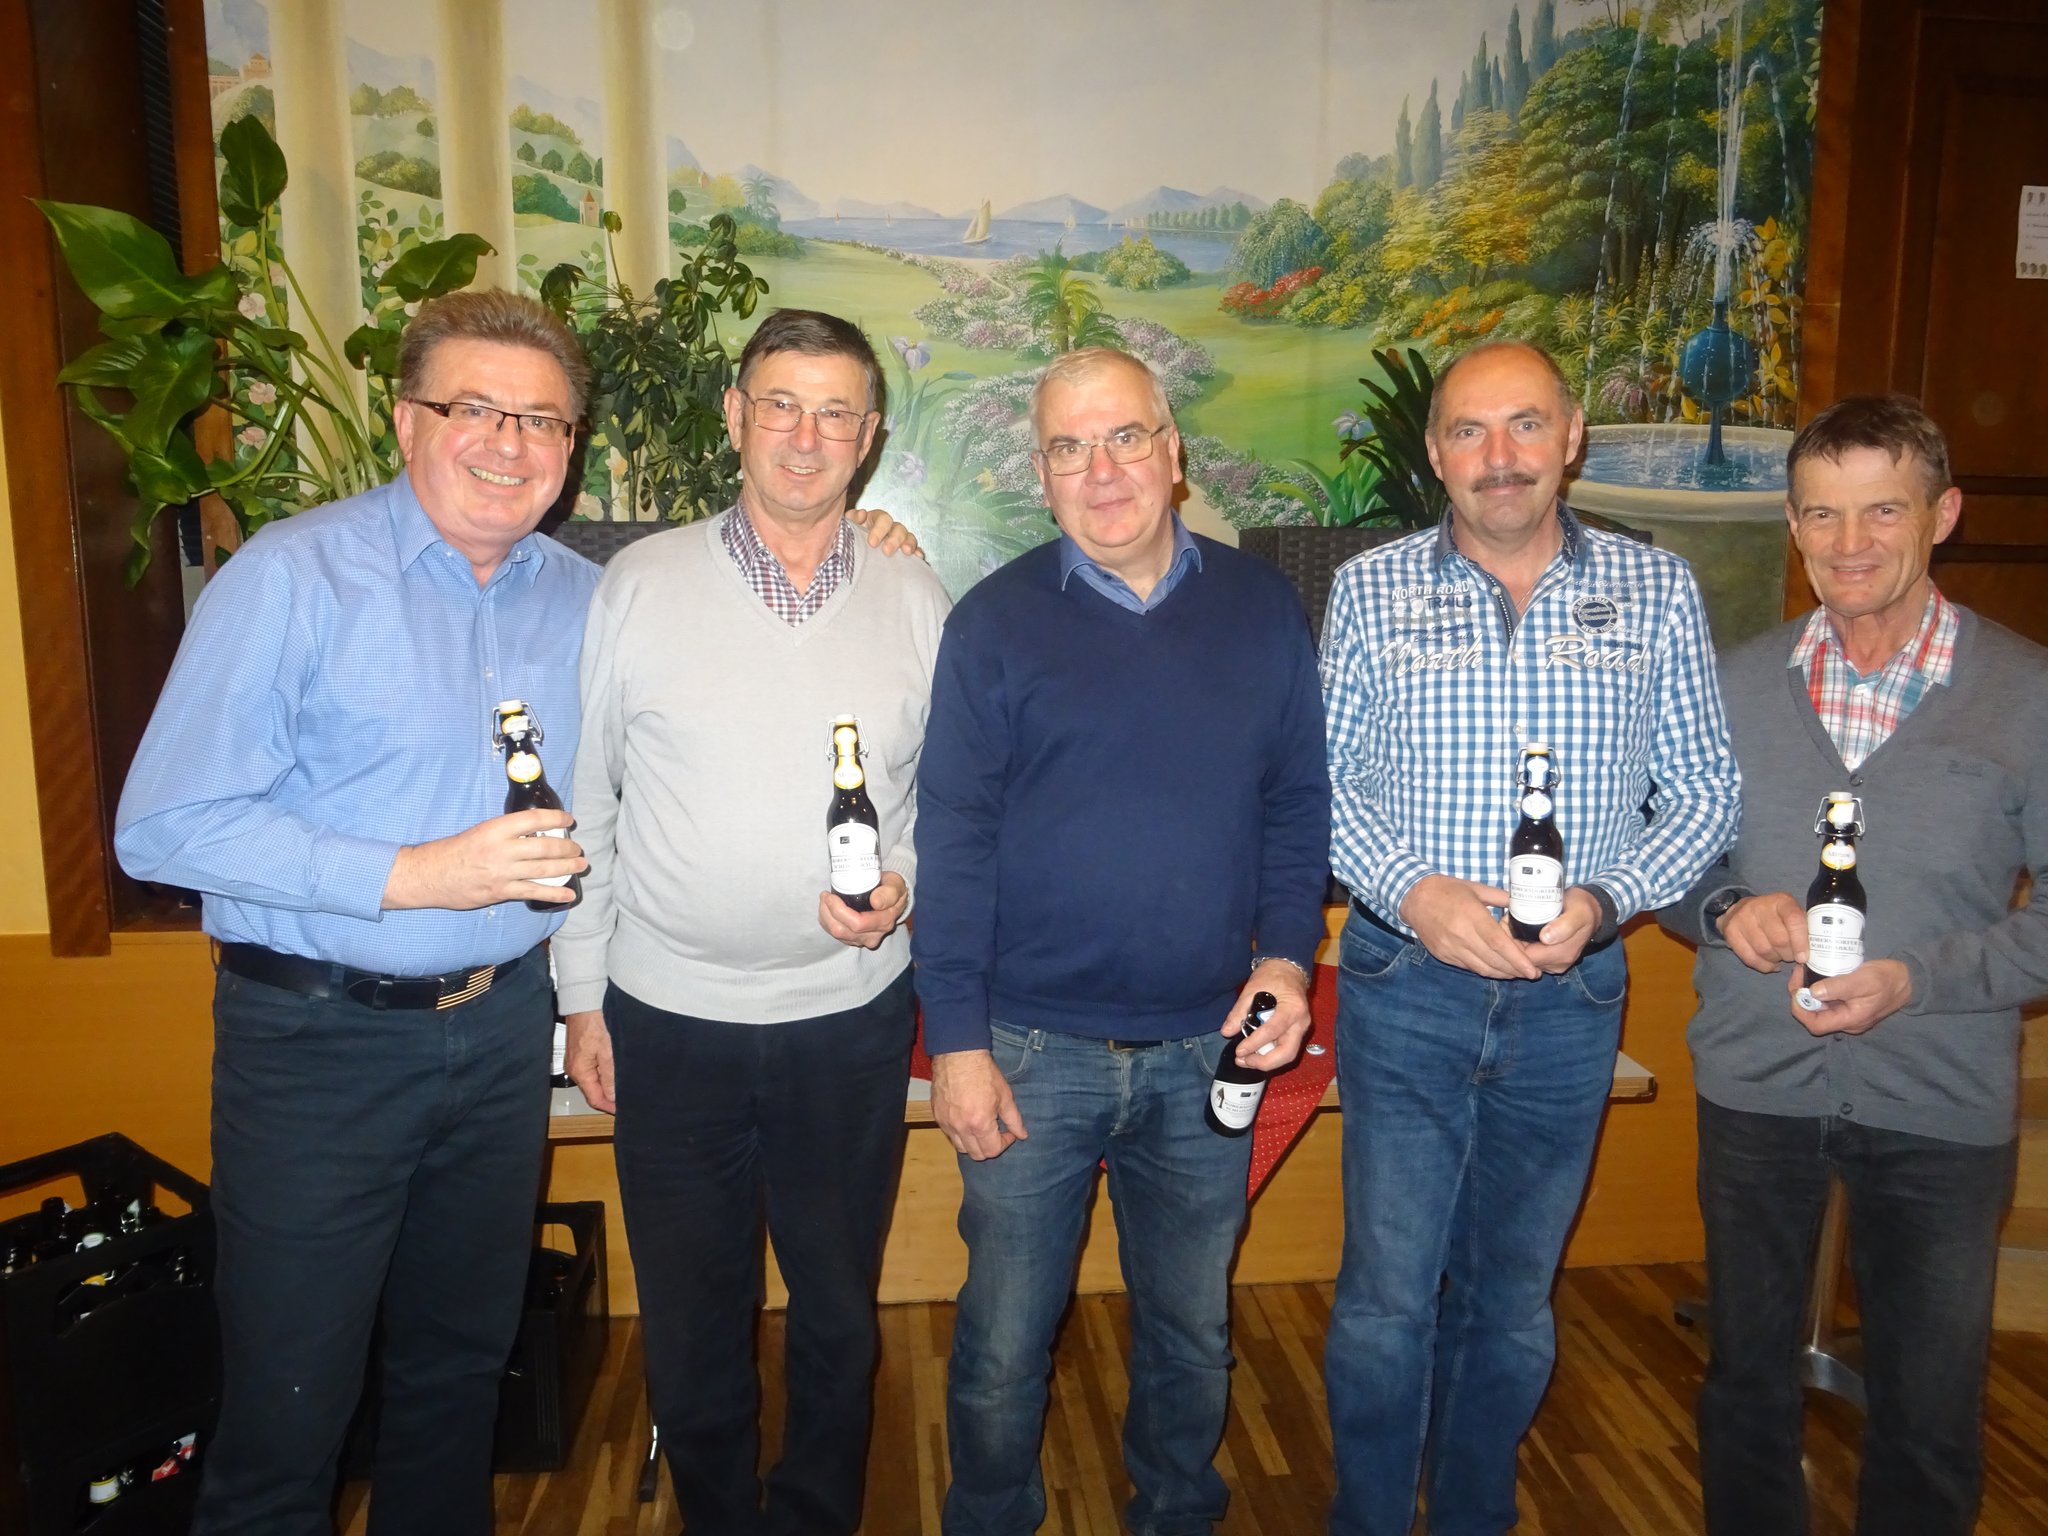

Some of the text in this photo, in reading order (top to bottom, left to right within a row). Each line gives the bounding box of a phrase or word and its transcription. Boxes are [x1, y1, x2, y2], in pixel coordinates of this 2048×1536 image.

[1391, 580, 1470, 600] NORTH ROAD
[1425, 596, 1472, 610] TRAILS
[1379, 633, 1483, 679] North
[1545, 634, 1649, 675] Road
